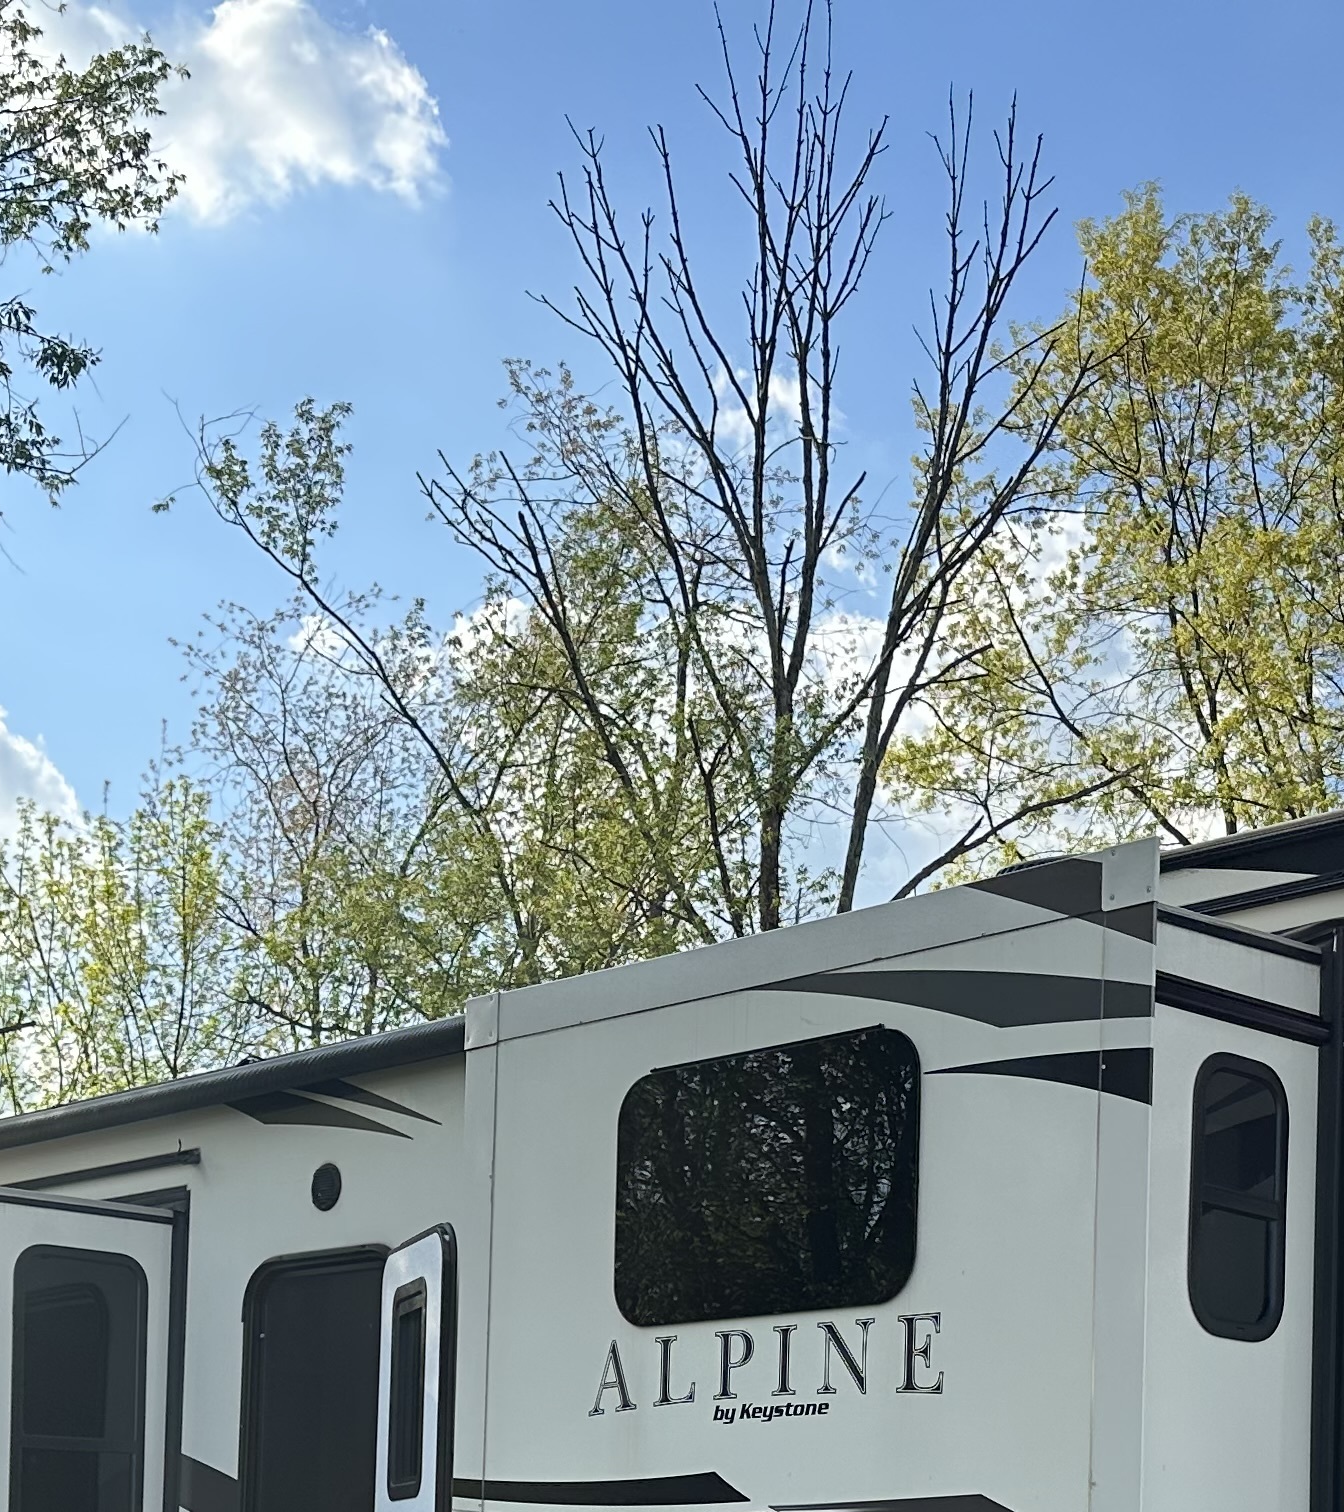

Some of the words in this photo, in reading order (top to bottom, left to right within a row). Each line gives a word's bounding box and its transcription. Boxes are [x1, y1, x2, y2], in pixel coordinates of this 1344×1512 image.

[588, 1311, 945, 1417] ALPINE
[713, 1405, 737, 1424] by
[739, 1402, 830, 1422] Keystone
